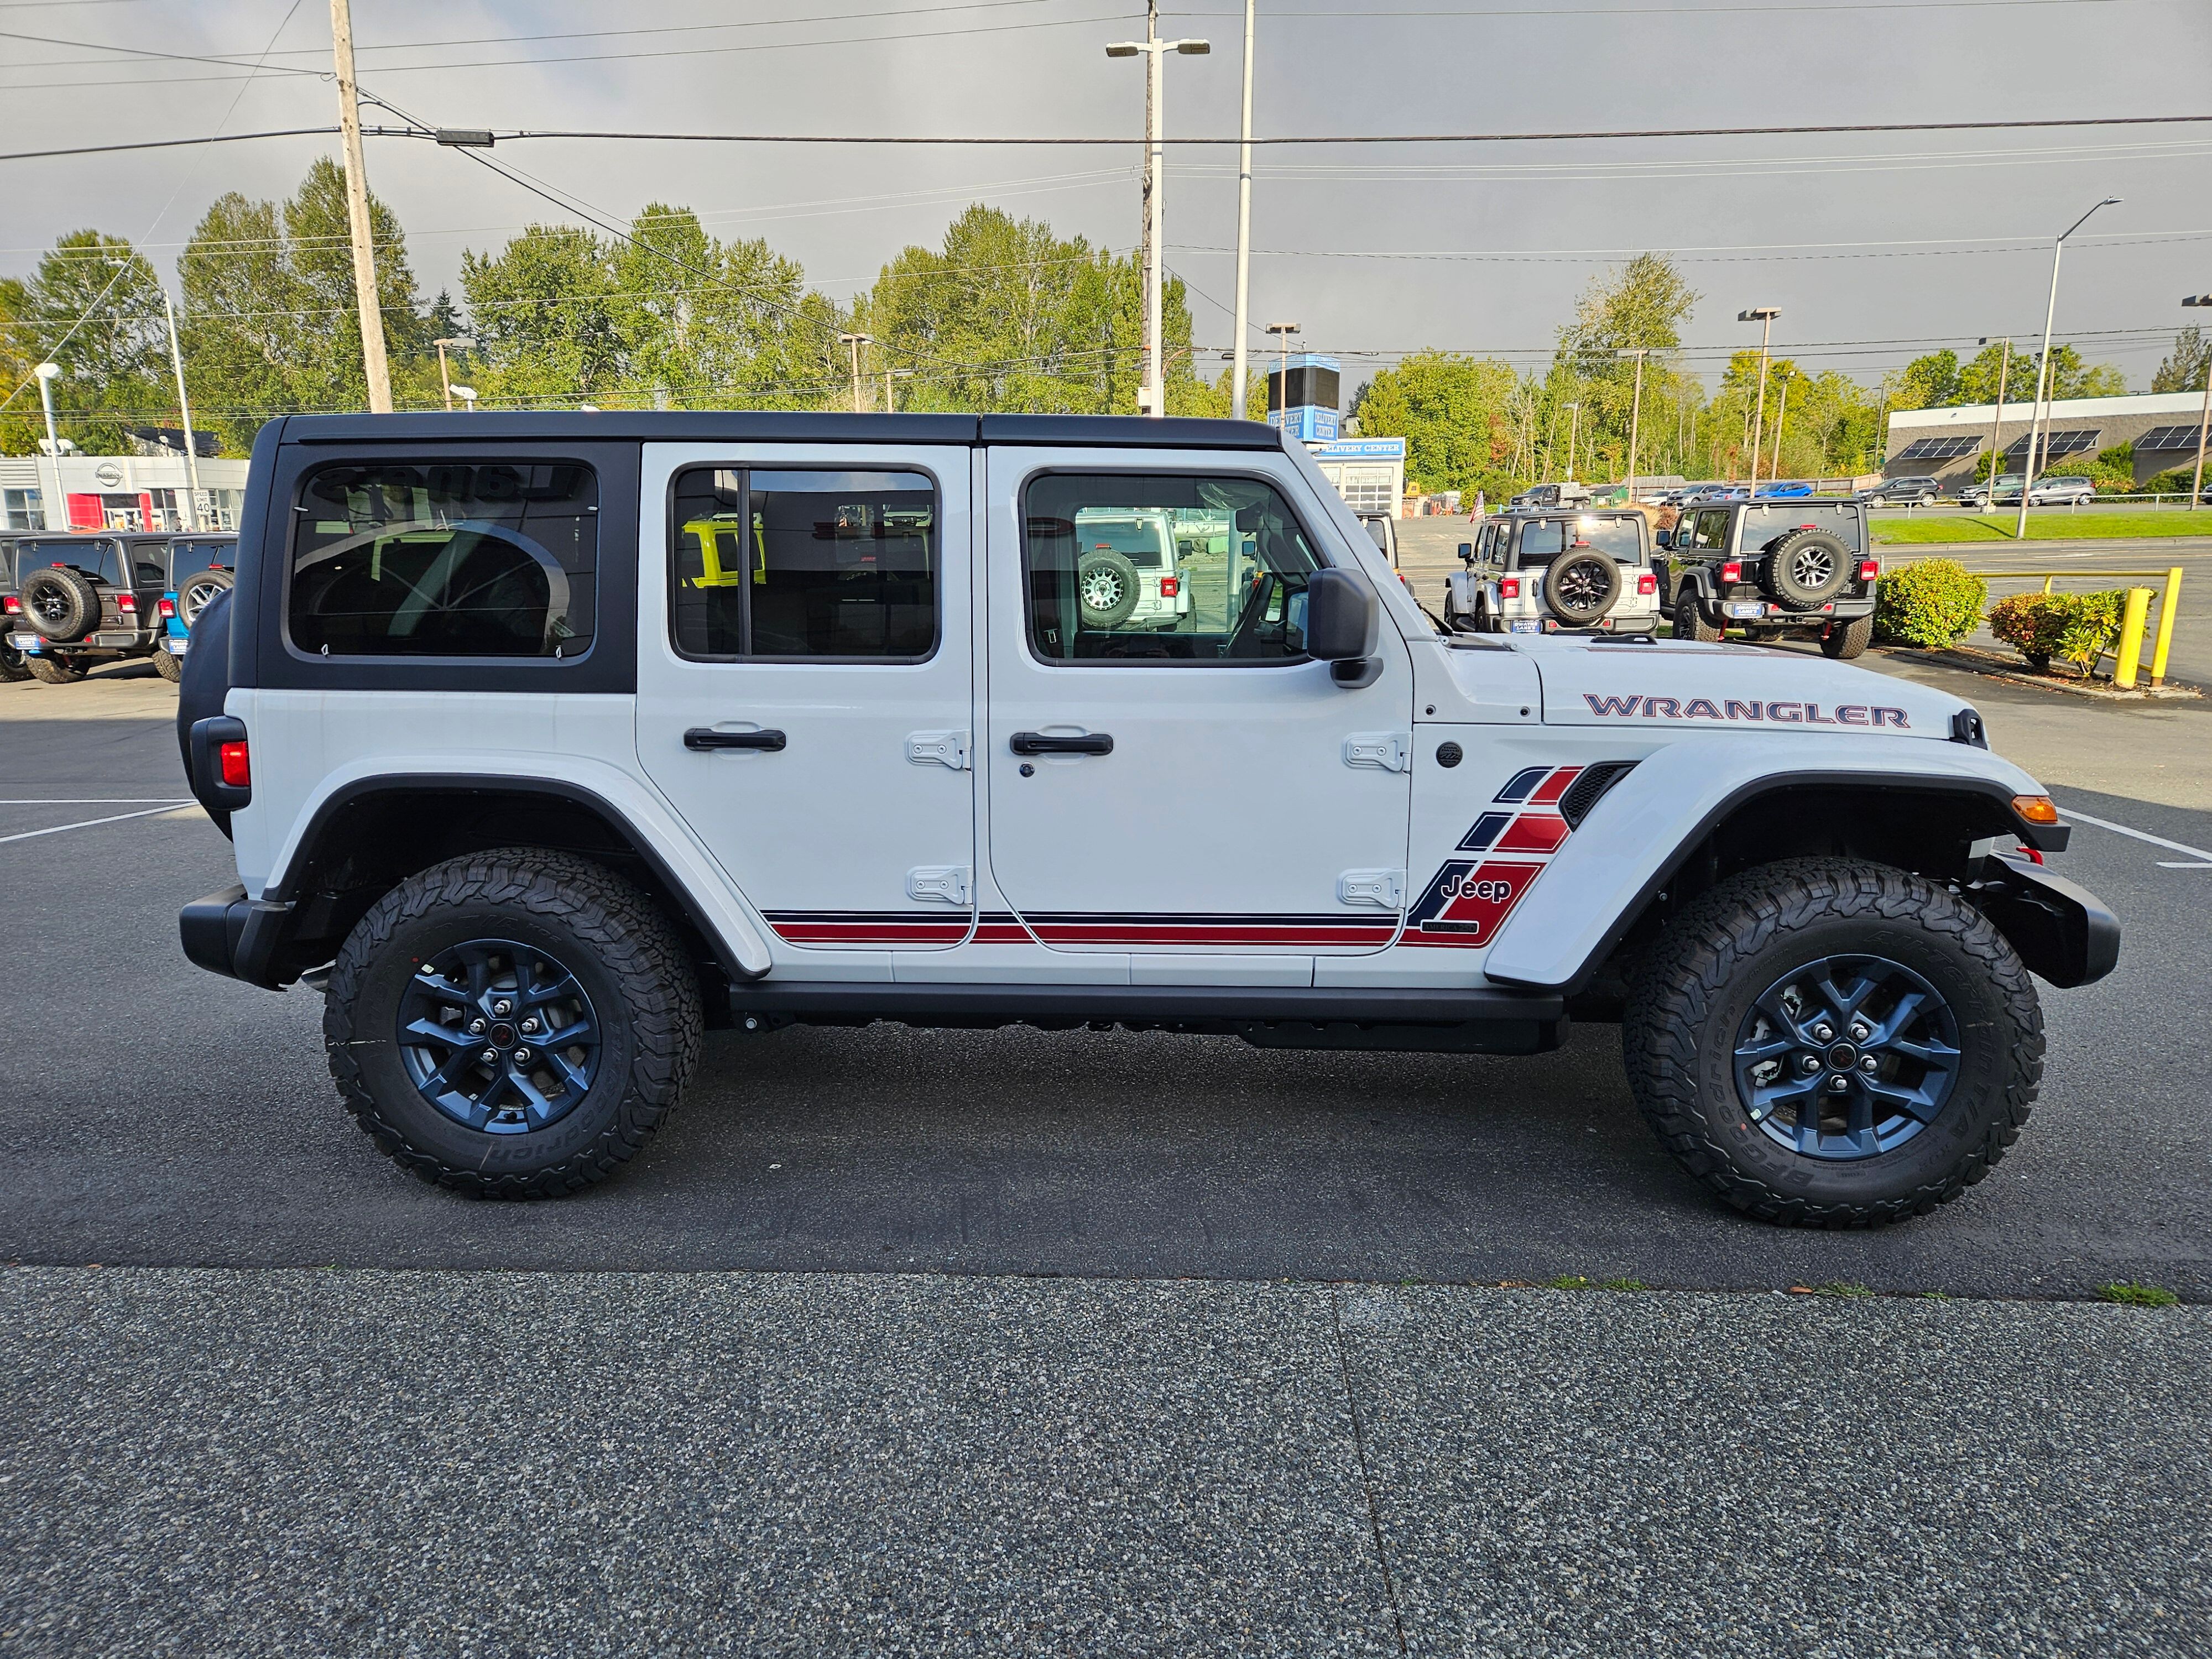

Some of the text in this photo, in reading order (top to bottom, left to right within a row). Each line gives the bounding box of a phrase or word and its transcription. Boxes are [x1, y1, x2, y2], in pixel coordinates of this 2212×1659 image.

[1315, 411, 1337, 425] DELIVERY
[1316, 424, 1334, 437] CENTER
[197, 503, 210, 513] 40
[1583, 694, 1911, 728] WRANGLER
[1441, 875, 1512, 904] Jeep
[1458, 924, 1476, 932] 250
[1709, 1003, 1815, 1187] BFGoodrich
